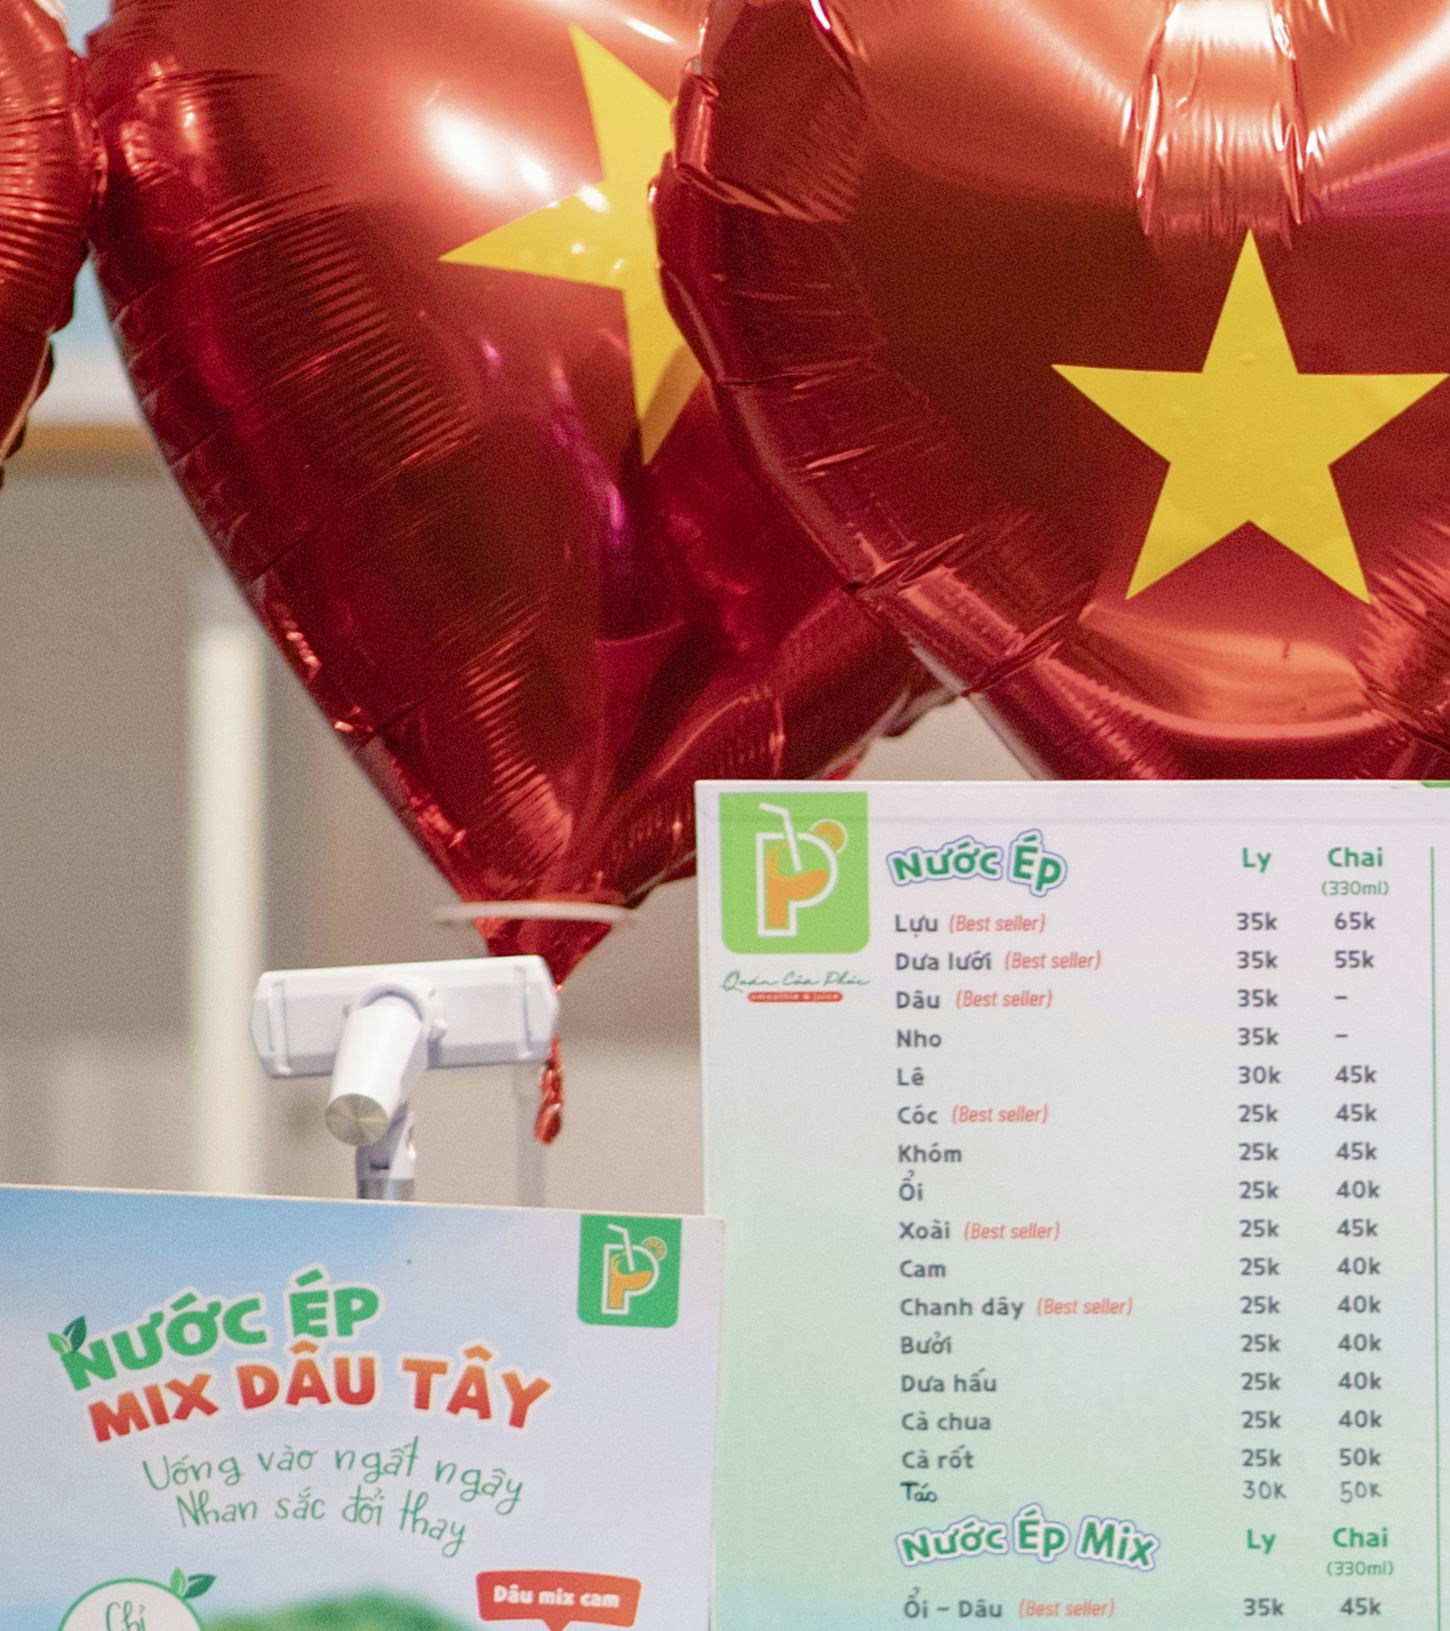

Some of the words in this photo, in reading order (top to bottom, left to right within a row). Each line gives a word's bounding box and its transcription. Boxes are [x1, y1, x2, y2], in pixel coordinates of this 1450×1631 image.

[892, 841, 998, 880] Nước
[1013, 835, 1061, 891] Ép
[1243, 848, 1271, 873] Ly
[1328, 847, 1383, 867] Chai
[1321, 881, 1389, 896] (330ml)
[895, 914, 938, 937] Lựu
[949, 914, 991, 933] (Best
[995, 914, 1046, 933] seller)
[1237, 912, 1277, 931] 35k
[1334, 911, 1375, 930] 65k
[896, 953, 940, 971] Dưa
[949, 950, 991, 971] lưới
[1005, 951, 1046, 970] (Best
[1051, 951, 1102, 970] seller)
[1237, 950, 1277, 969] 35k
[1335, 950, 1374, 969] 55k
[898, 1143, 962, 1163] Khóm
[1239, 1142, 1278, 1161] 25k
[1336, 1142, 1377, 1160] 45k
[898, 1169, 924, 1202] Ổi
[1239, 1181, 1278, 1199] 25k
[1336, 1180, 1380, 1199] 40k
[899, 1220, 950, 1240] Xoài
[964, 1222, 1006, 1241] (Best
[1010, 1221, 1060, 1240] seller)
[1240, 1219, 1279, 1238] 25k
[1337, 1218, 1377, 1237] 45k
[900, 1259, 947, 1278] Cam
[1240, 1257, 1279, 1276] 25k
[1337, 1257, 1380, 1275] 40k
[61, 1292, 267, 1391] NƯỚC
[289, 1269, 379, 1337] ÉP
[901, 1331, 952, 1355] Bưởi
[1241, 1334, 1280, 1352] 25k
[1338, 1333, 1381, 1352] 40k
[88, 1373, 219, 1442] MIX
[237, 1342, 376, 1411] DÂU
[402, 1345, 551, 1429] TÂY
[901, 1374, 945, 1393] Dưa
[954, 1368, 997, 1392] hấu
[1241, 1372, 1280, 1391] 25k
[1338, 1372, 1381, 1390] 40k
[143, 1455, 243, 1491] Uống
[335, 1436, 420, 1483] ngất
[434, 1459, 524, 1516] ngây
[176, 1491, 257, 1528] Nhan
[275, 1488, 326, 1520] sắc
[342, 1485, 383, 1526] đổi
[399, 1489, 467, 1558] thay
[901, 1521, 1004, 1561] Nước
[1018, 1510, 1065, 1557] Ép
[1081, 1522, 1155, 1566] Mix
[1247, 1529, 1276, 1554] Ly
[1333, 1527, 1388, 1548] Chai
[1326, 1561, 1394, 1576] (330ml)
[492, 1586, 534, 1609] Dâu
[539, 1587, 574, 1608] mix
[580, 1589, 620, 1609] cam
